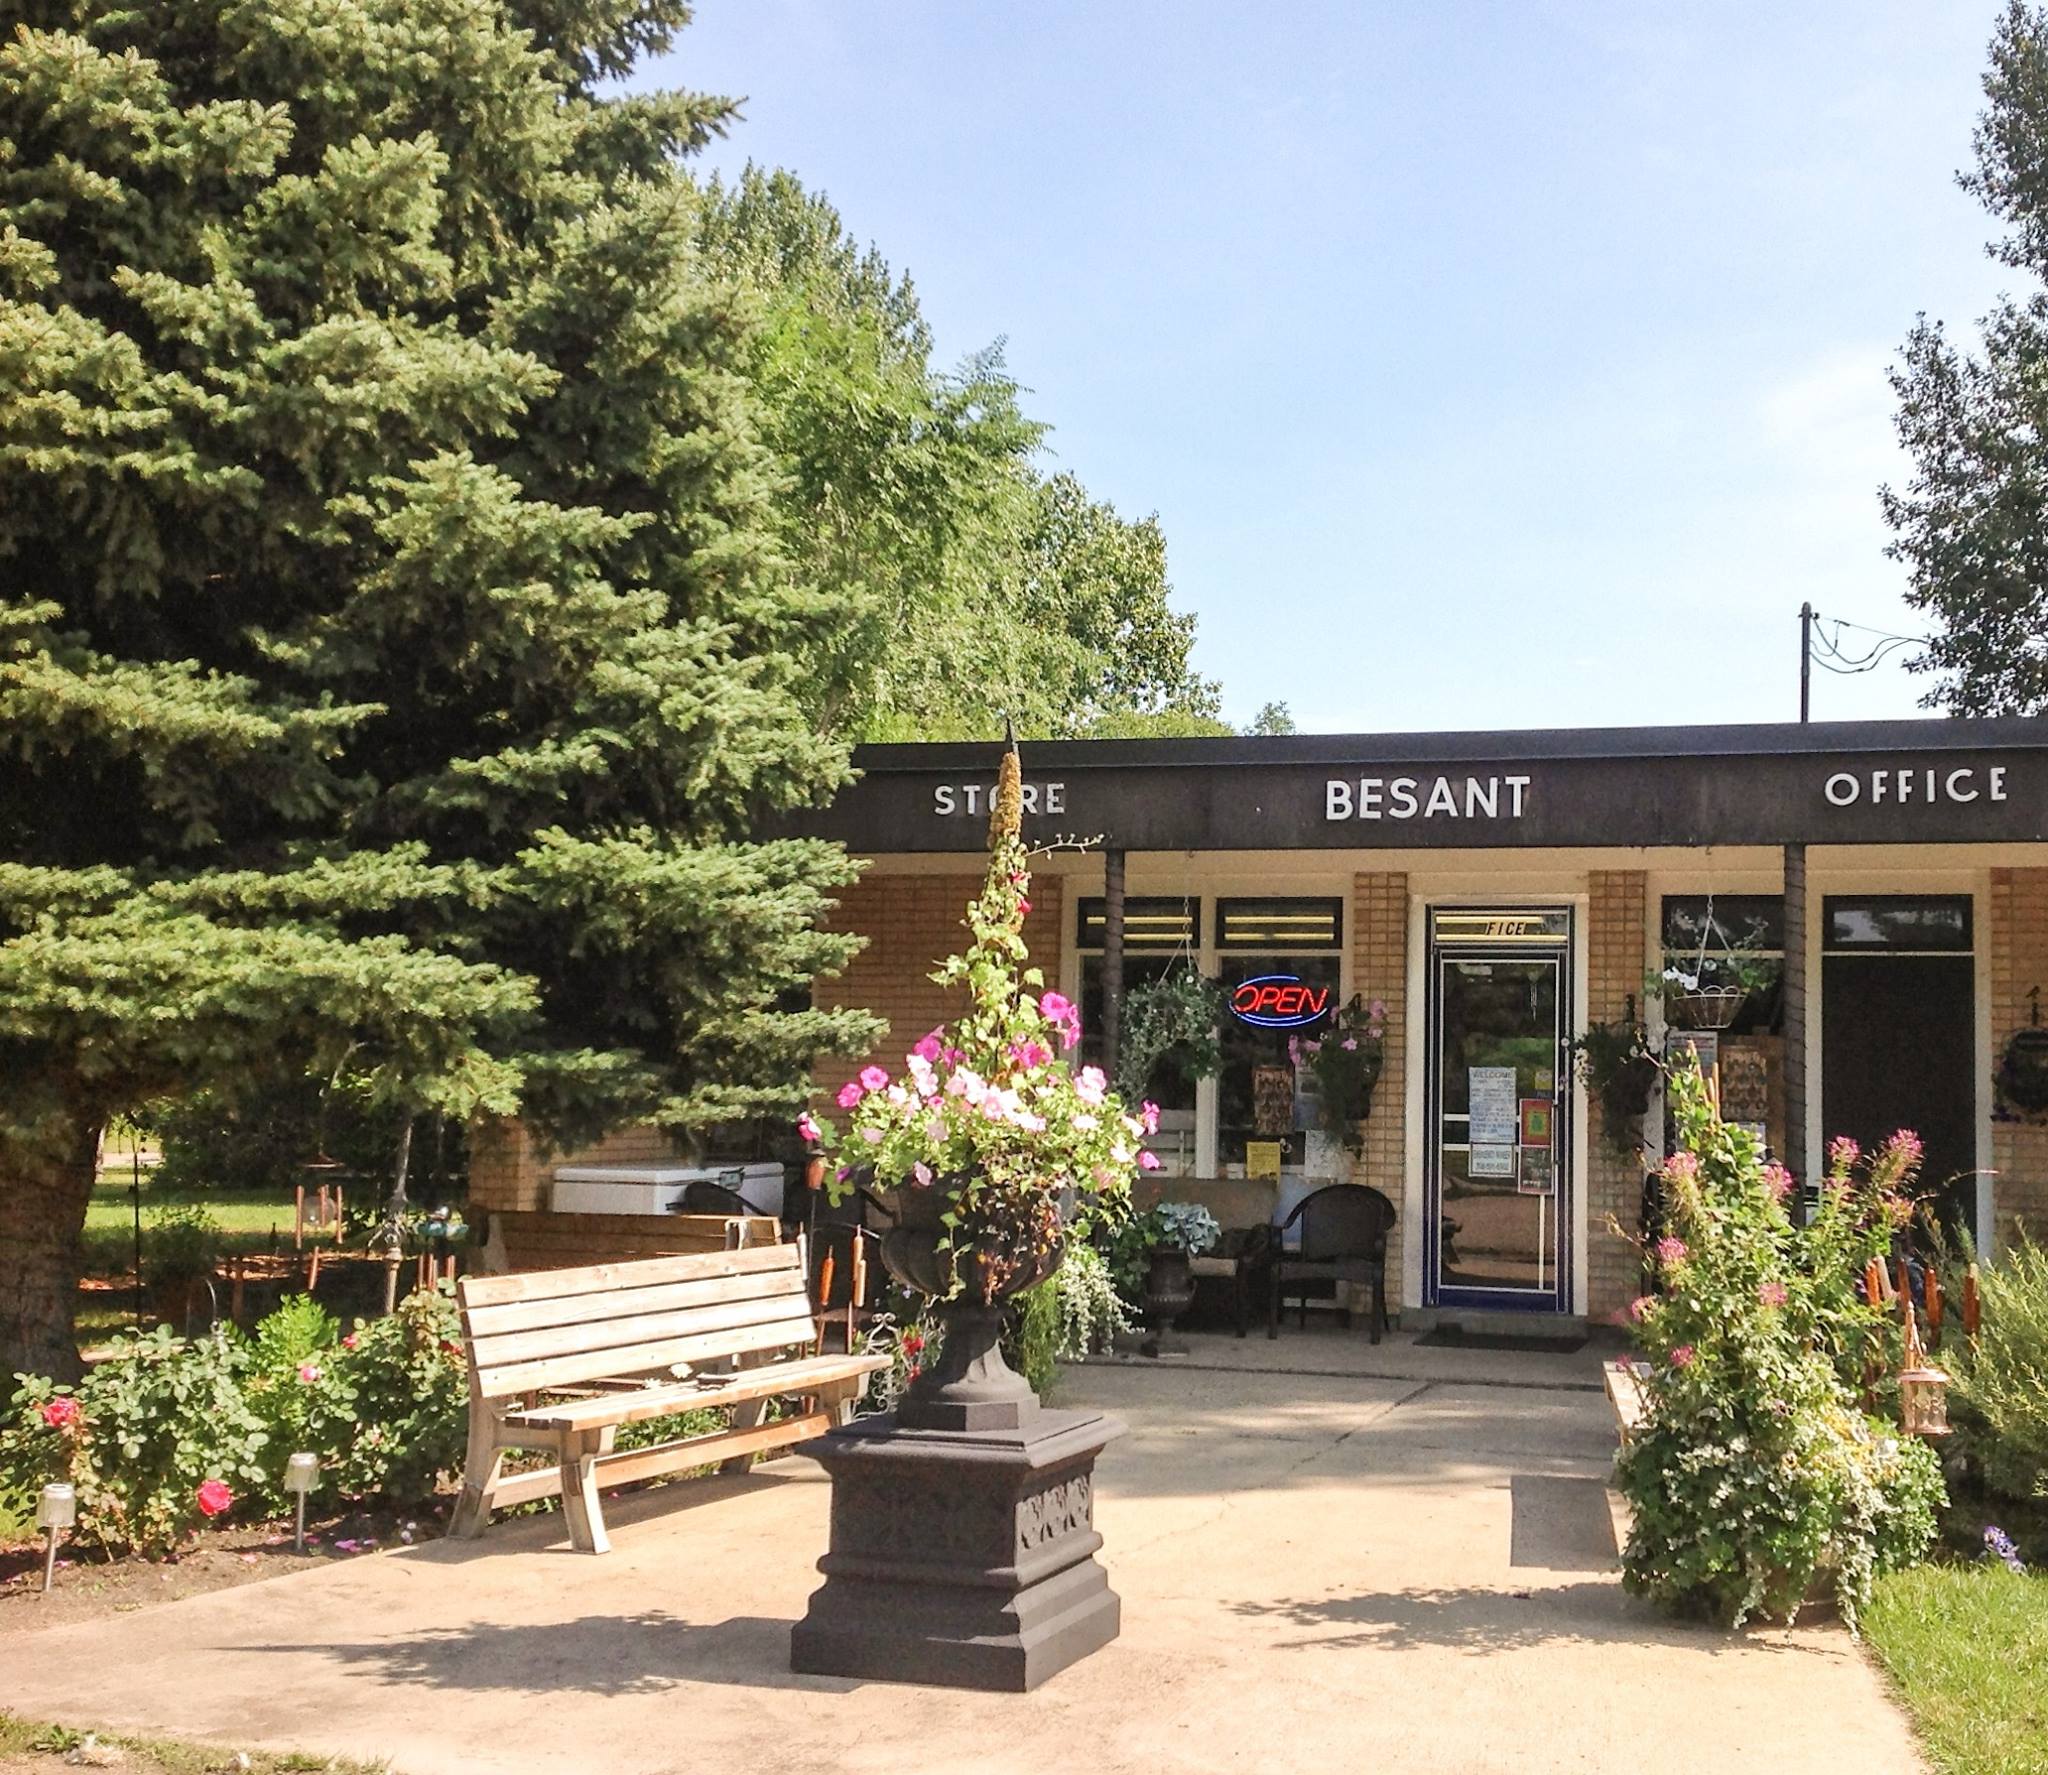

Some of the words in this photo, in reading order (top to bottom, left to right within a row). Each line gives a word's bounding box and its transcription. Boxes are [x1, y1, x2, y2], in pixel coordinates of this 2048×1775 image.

[1326, 776, 1531, 820] BESANT
[1825, 767, 2007, 806] OFFICE
[1233, 985, 1328, 1013] OPEN
